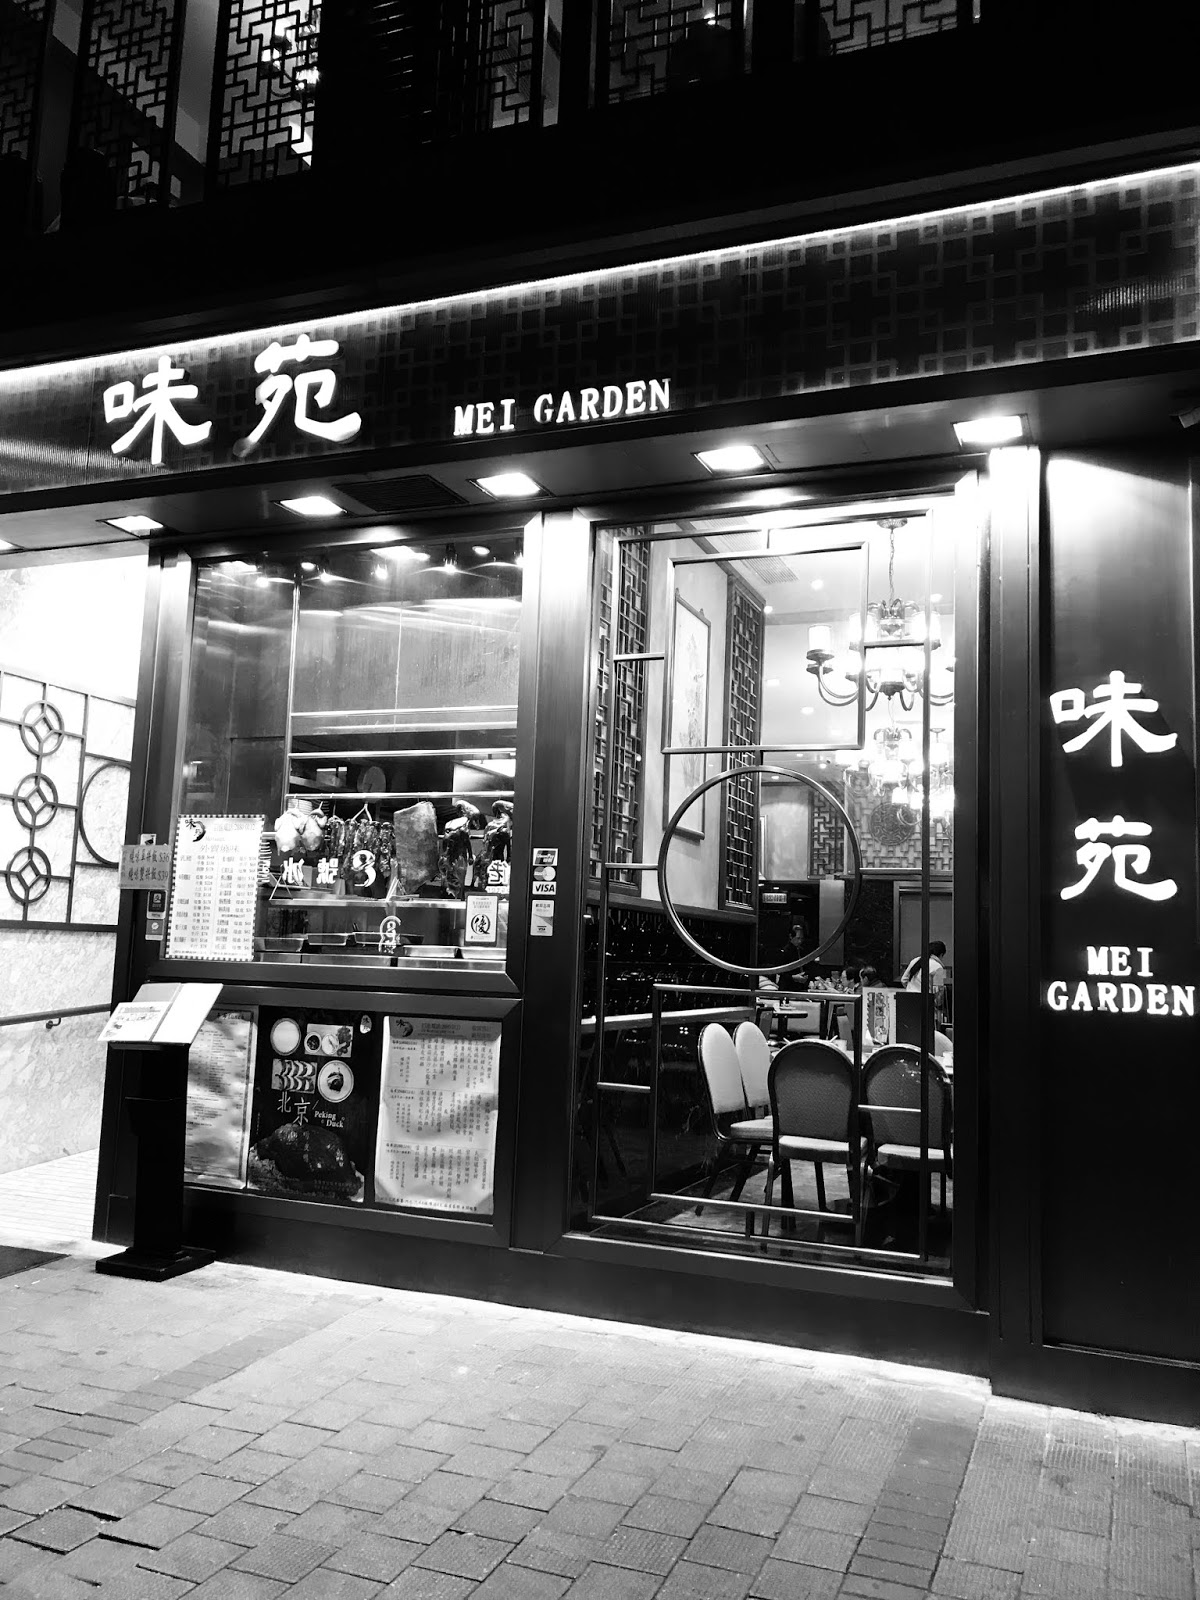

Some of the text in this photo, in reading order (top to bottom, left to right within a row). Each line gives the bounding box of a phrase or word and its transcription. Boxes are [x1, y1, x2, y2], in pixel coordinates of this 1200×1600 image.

[103, 334, 362, 465] 味苑
[453, 378, 671, 436] MEI GARDEN
[1050, 670, 1178, 901] 味苑
[535, 883, 555, 893] VISA
[1047, 946, 1195, 1016] MEI GARDEN
[277, 1091, 311, 1126] 北京
[314, 1111, 337, 1120] Peking
[326, 1120, 344, 1128] Duck
